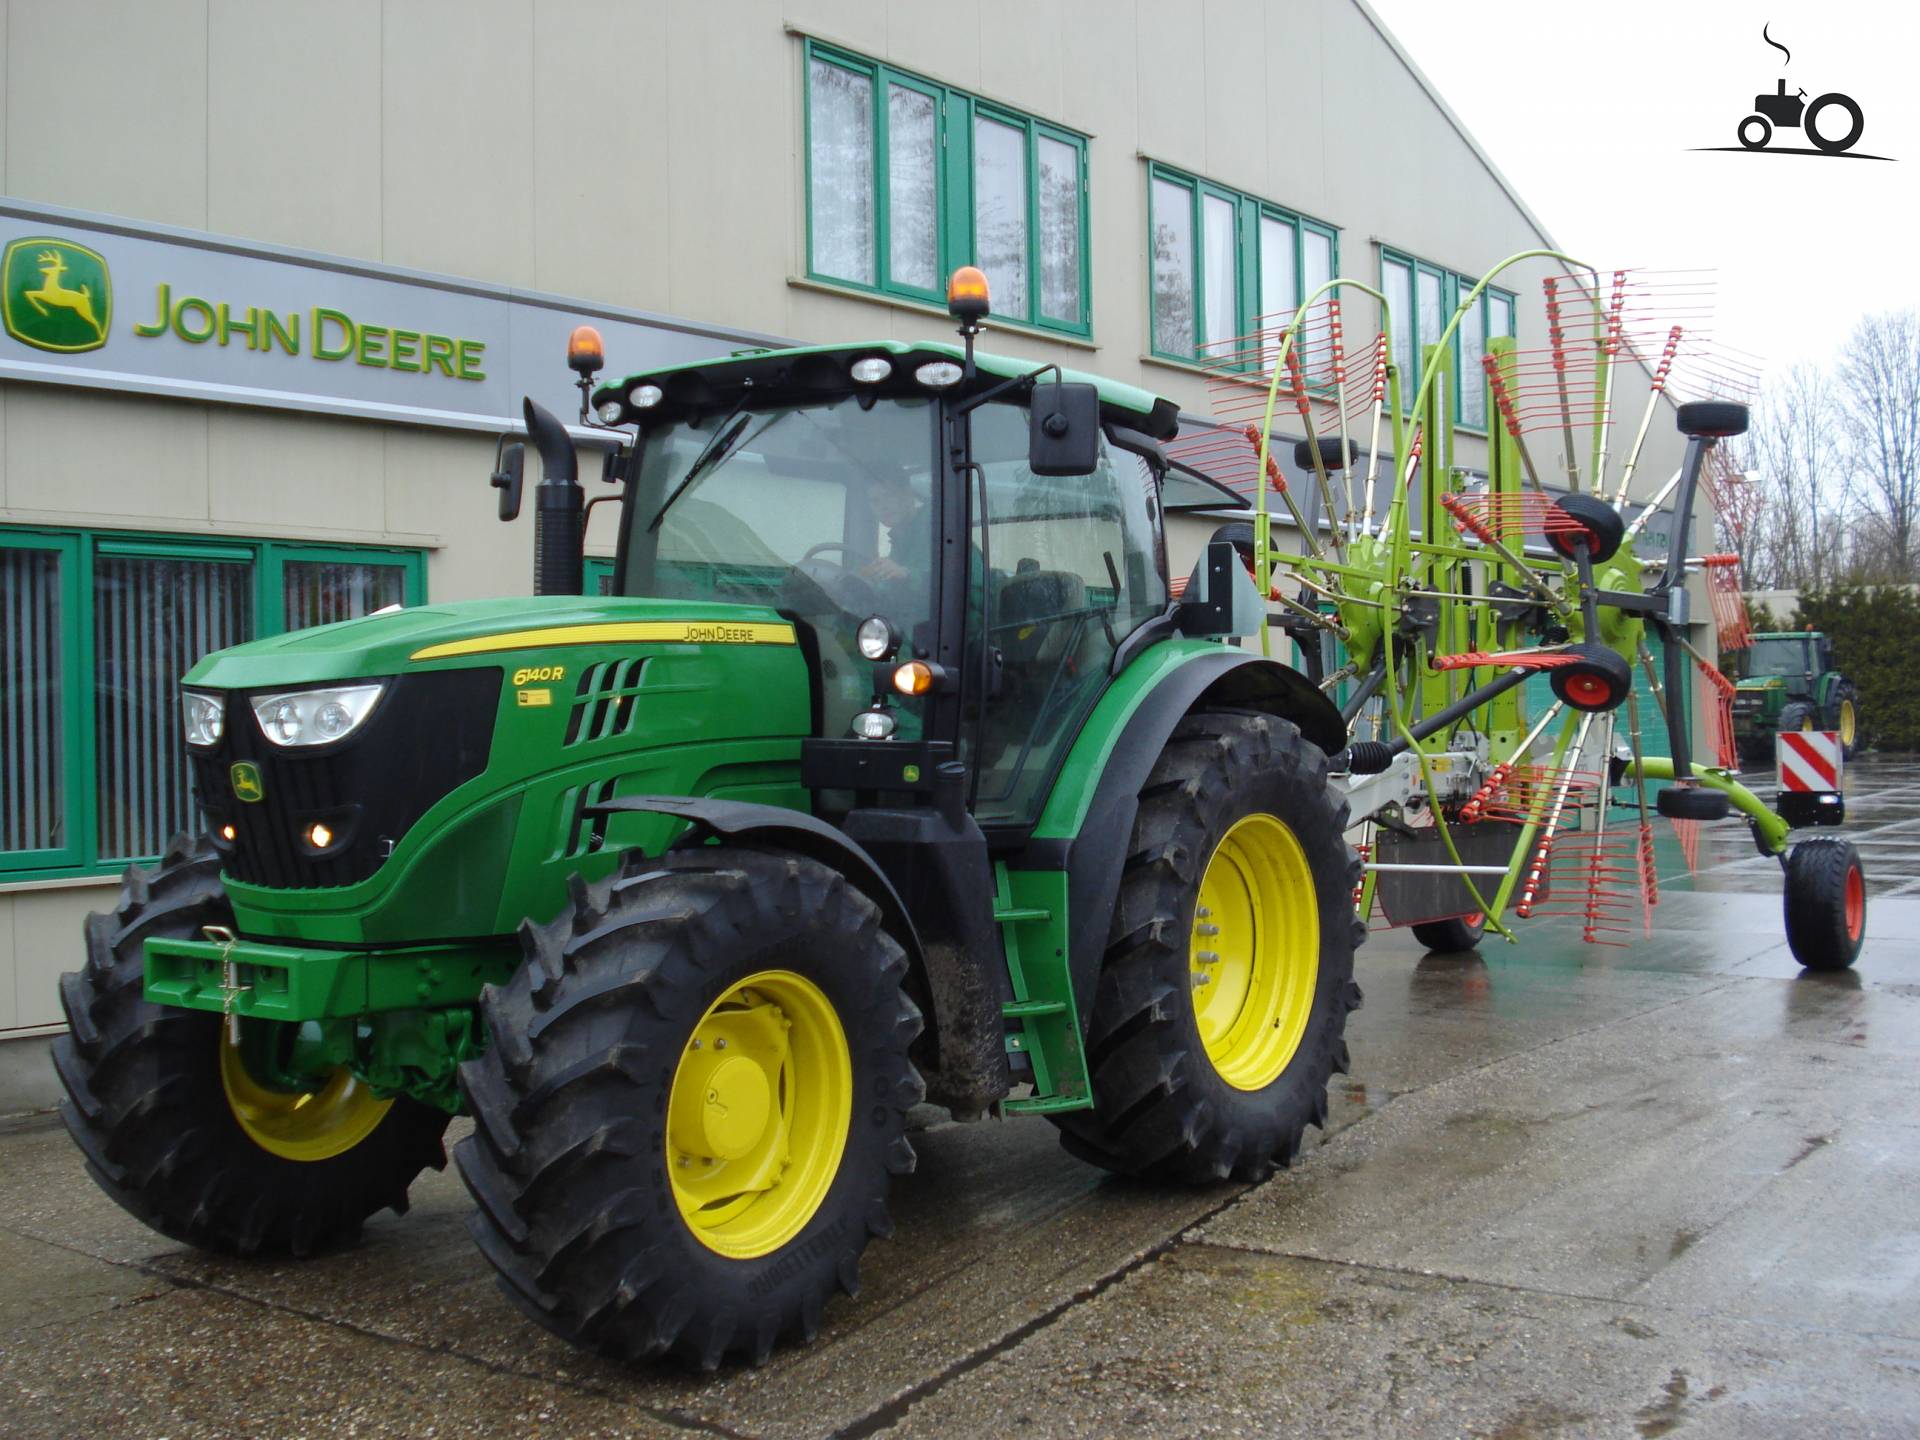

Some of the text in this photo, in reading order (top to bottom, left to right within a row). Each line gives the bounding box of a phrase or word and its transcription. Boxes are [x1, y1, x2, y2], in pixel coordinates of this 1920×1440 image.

[135, 283, 486, 380] JOHN DEERE
[684, 625, 754, 641] JOHN DEERE
